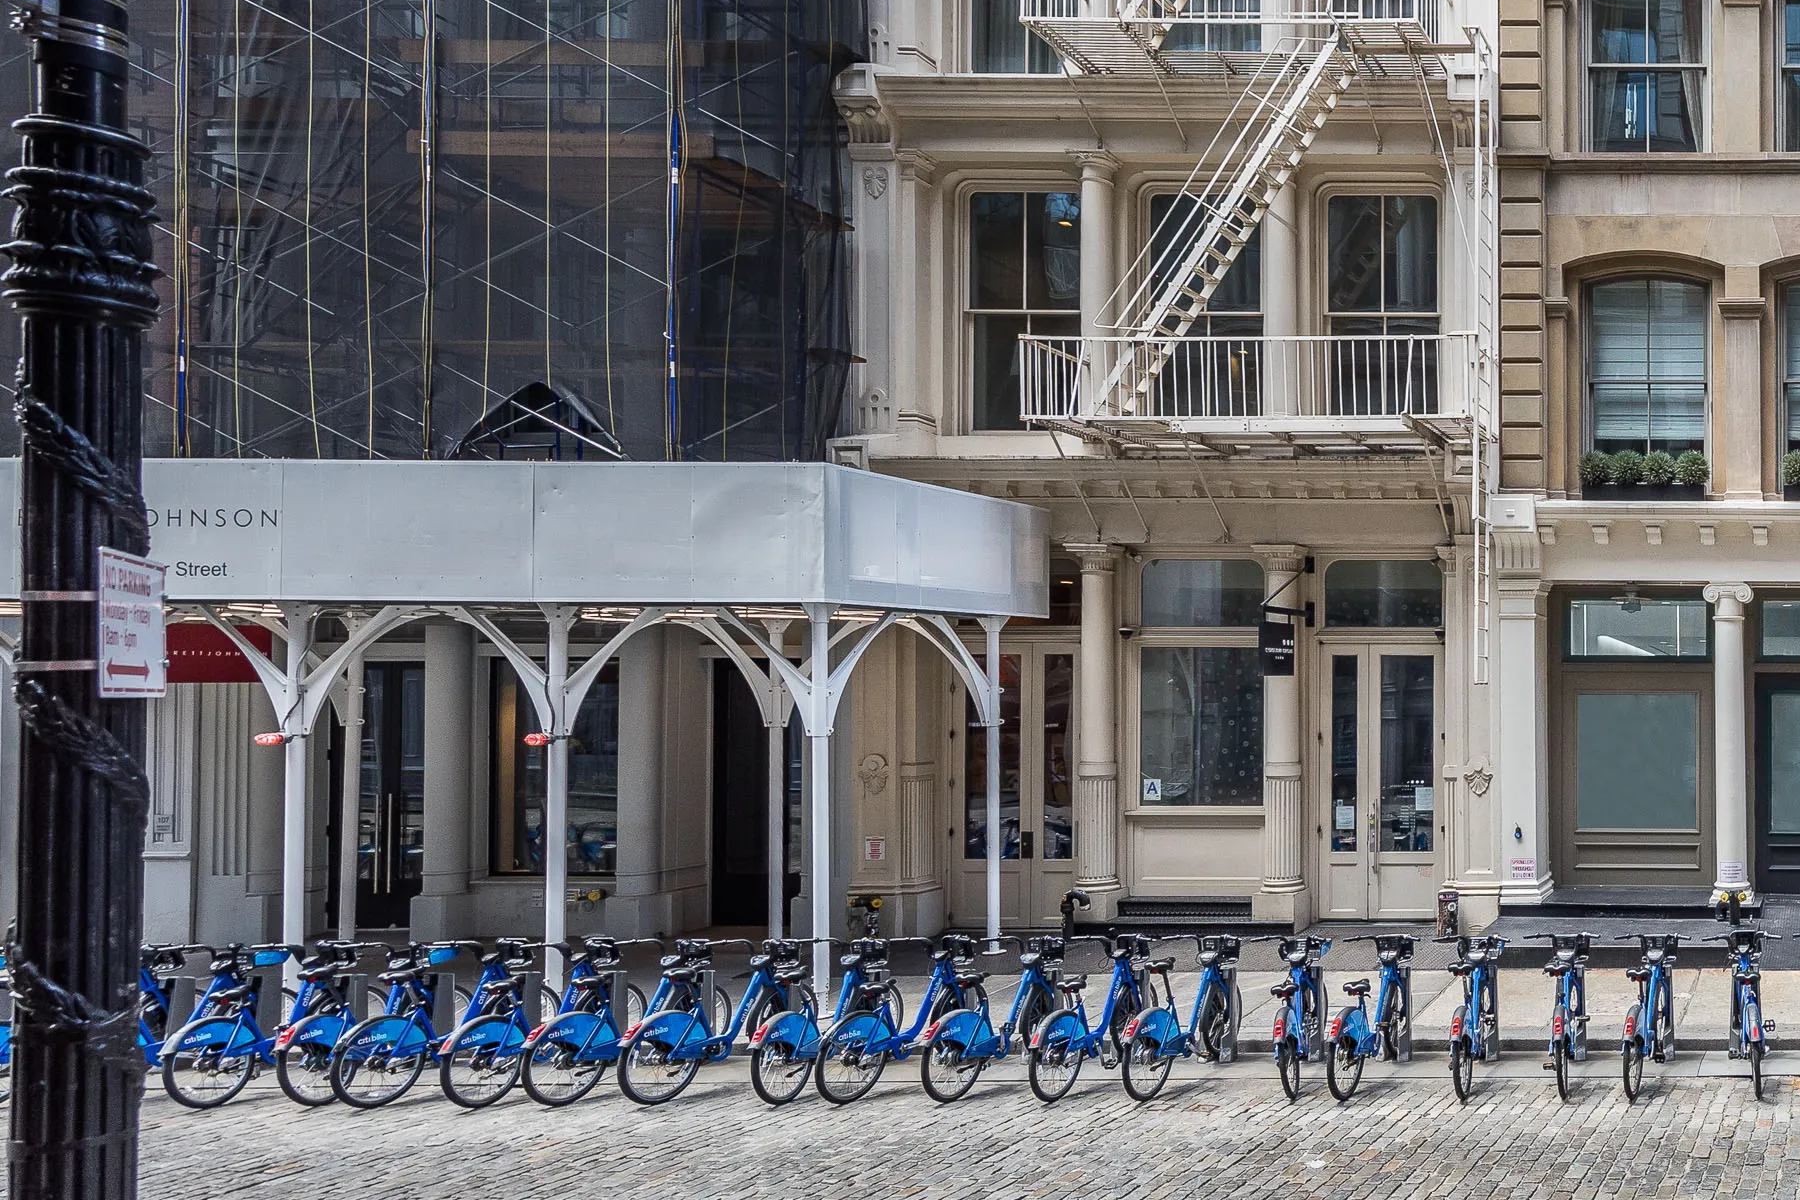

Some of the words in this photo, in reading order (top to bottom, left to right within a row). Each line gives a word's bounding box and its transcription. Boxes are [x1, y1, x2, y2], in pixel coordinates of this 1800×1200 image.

[146, 509, 278, 527] OHNSON
[175, 562, 228, 577] Street
[105, 564, 116, 590] NO
[118, 568, 151, 597] PARKING
[1146, 781, 1158, 794] A
